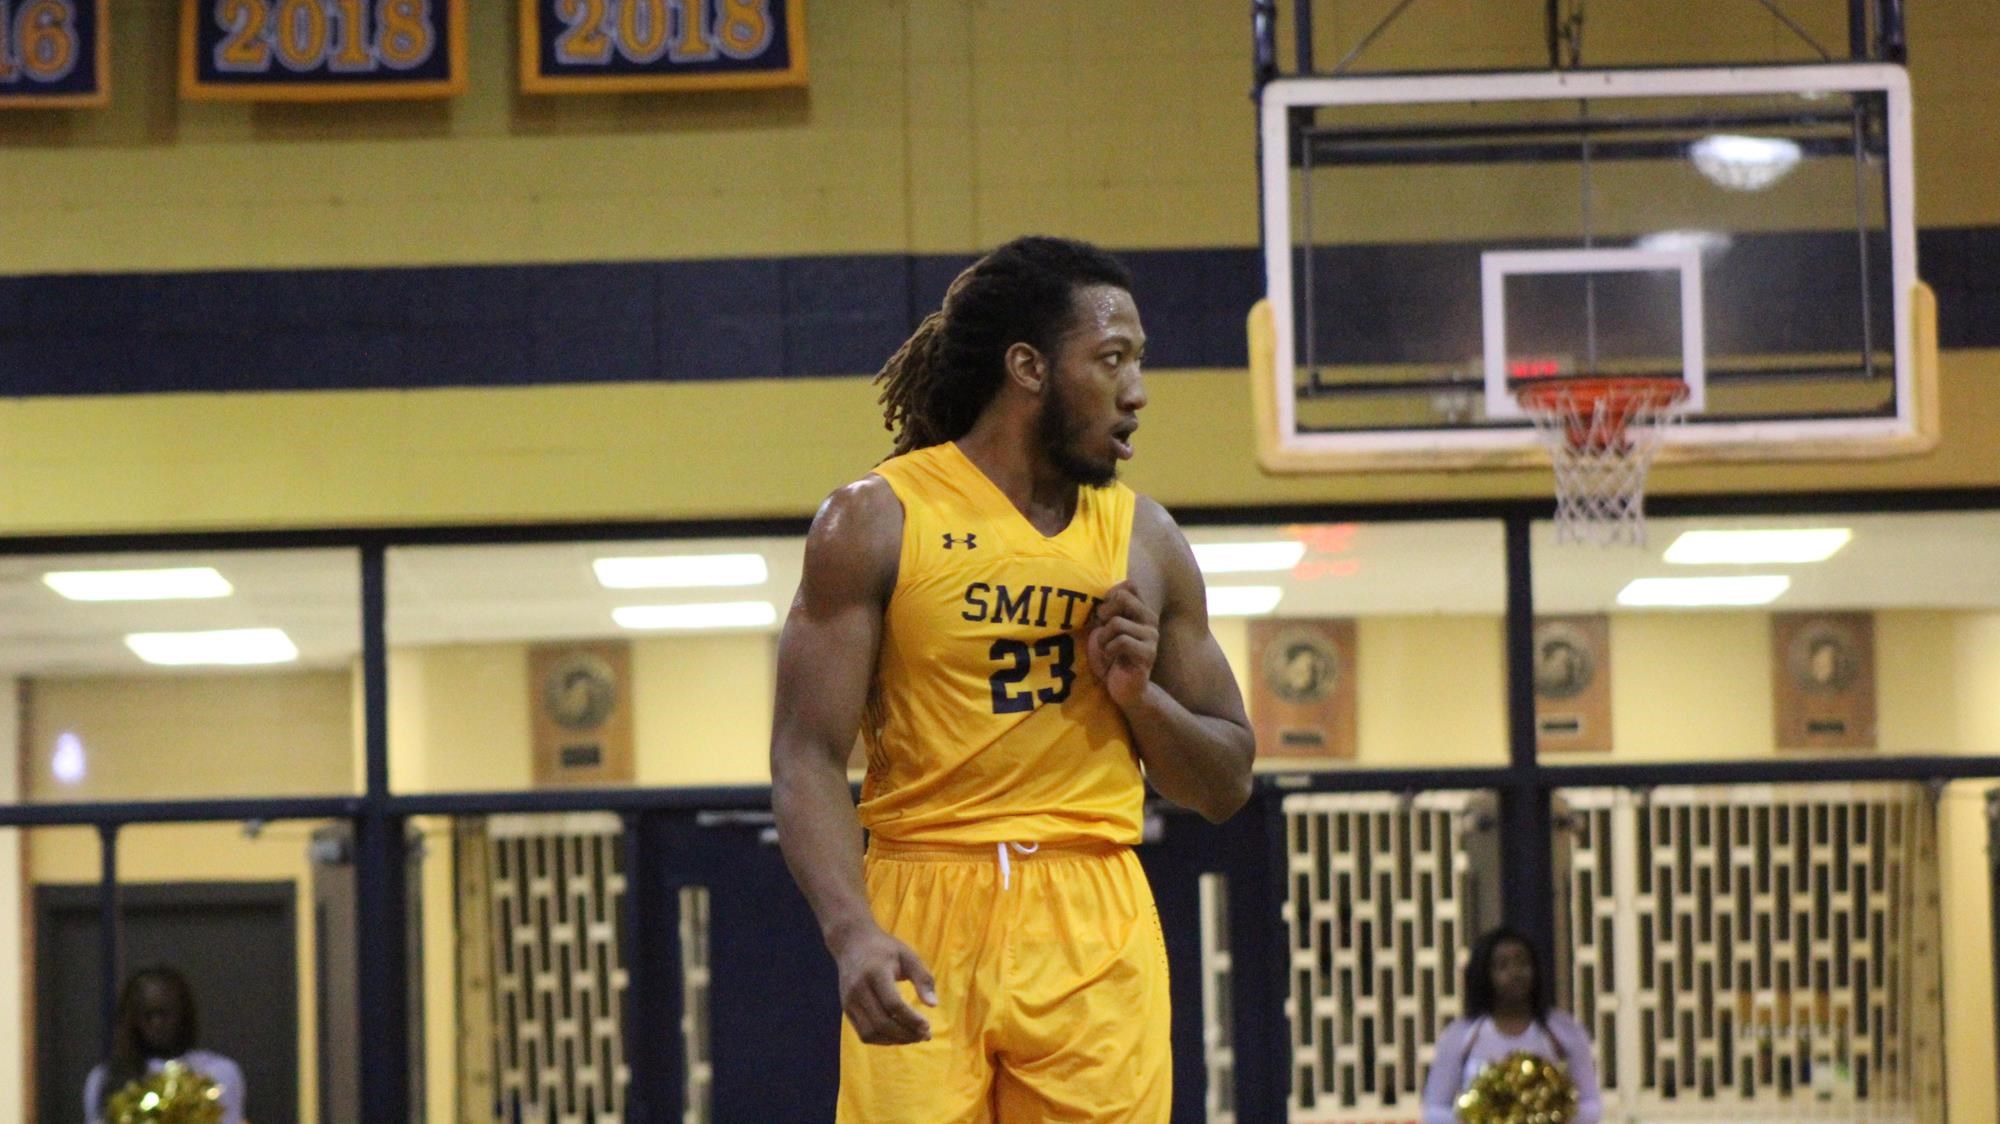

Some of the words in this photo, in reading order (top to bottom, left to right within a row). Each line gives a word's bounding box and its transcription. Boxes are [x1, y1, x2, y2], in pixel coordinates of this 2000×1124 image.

[213, 0, 436, 72] 2018
[554, 0, 774, 65] 2018
[989, 633, 1076, 714] 23
